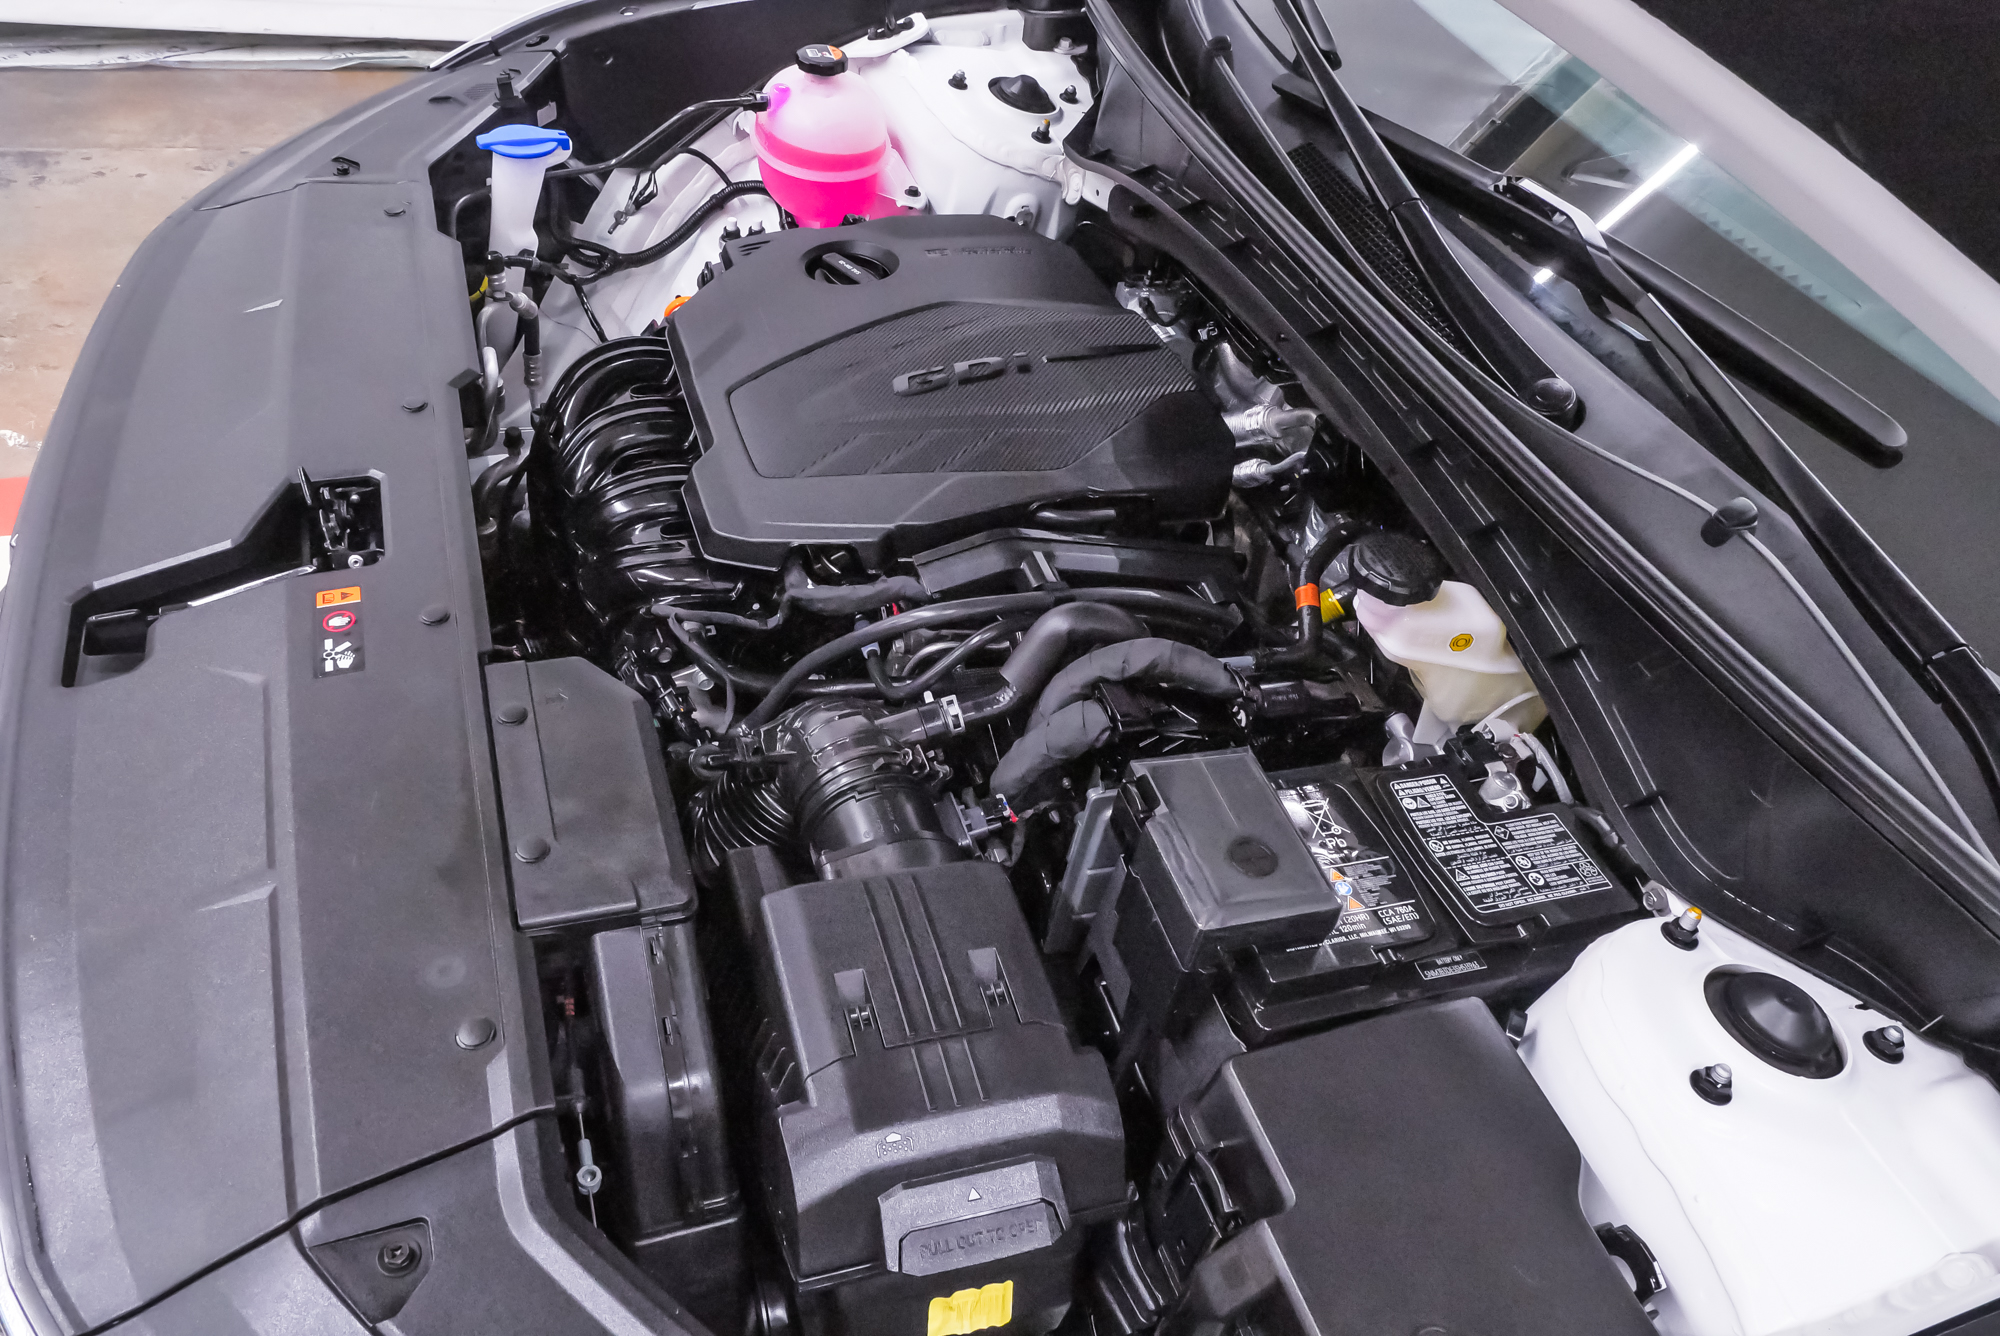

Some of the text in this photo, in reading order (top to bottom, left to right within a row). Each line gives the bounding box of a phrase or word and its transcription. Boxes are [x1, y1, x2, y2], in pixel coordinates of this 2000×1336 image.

[1325, 837, 1347, 849] Pb
[1377, 904, 1416, 918] CCA 760A
[1343, 912, 1370, 924] (20HR)
[1339, 922, 1367, 933] 120min
